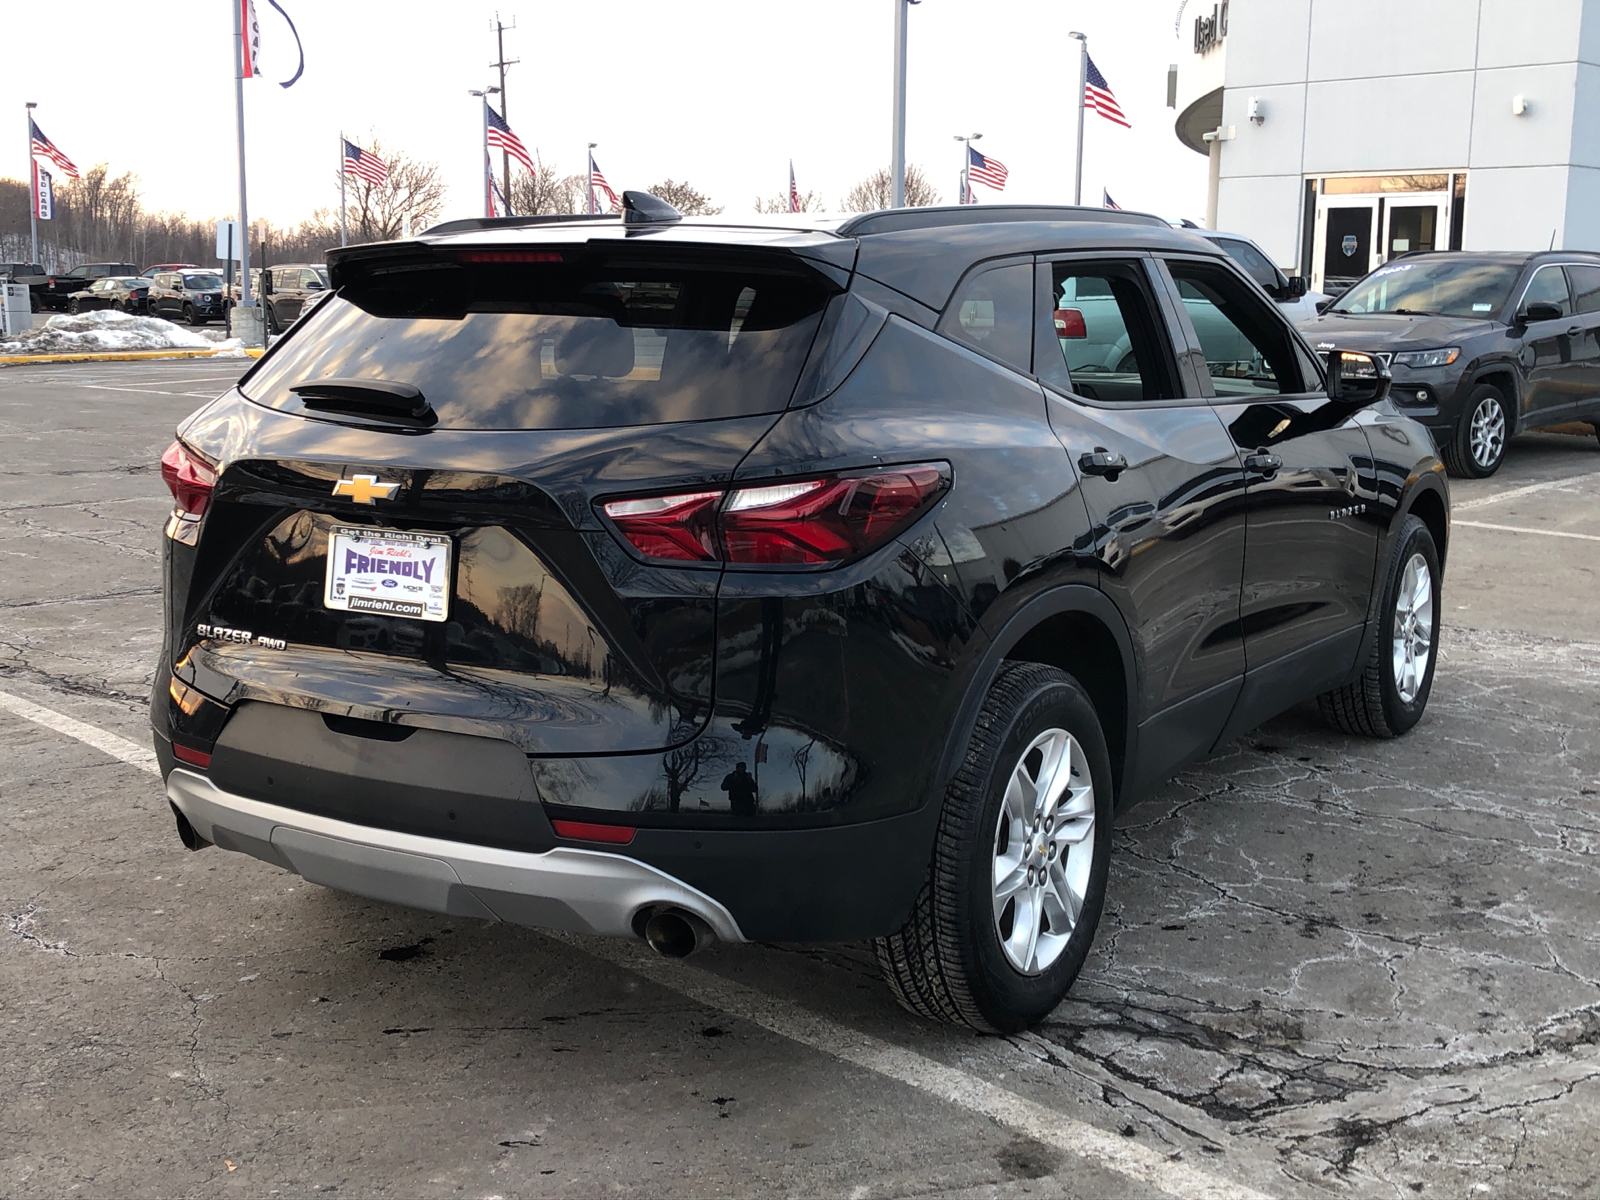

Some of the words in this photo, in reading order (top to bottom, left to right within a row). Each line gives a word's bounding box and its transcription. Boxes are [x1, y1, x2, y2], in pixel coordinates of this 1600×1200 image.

[1194, 3, 1218, 54] Used
[40, 191, 48, 217] CARS
[1330, 503, 1366, 520] BLAZER
[340, 528, 360, 537] Get
[363, 530, 381, 538] the
[384, 532, 412, 540] Riehl
[416, 535, 441, 543] Deal
[369, 546, 384, 556] Jim
[386, 547, 412, 558] Riehl's
[345, 548, 436, 584] FRIENDLY
[349, 597, 421, 614] jimriehl.com
[197, 623, 252, 645] BLAZER
[258, 636, 286, 650] AWD
